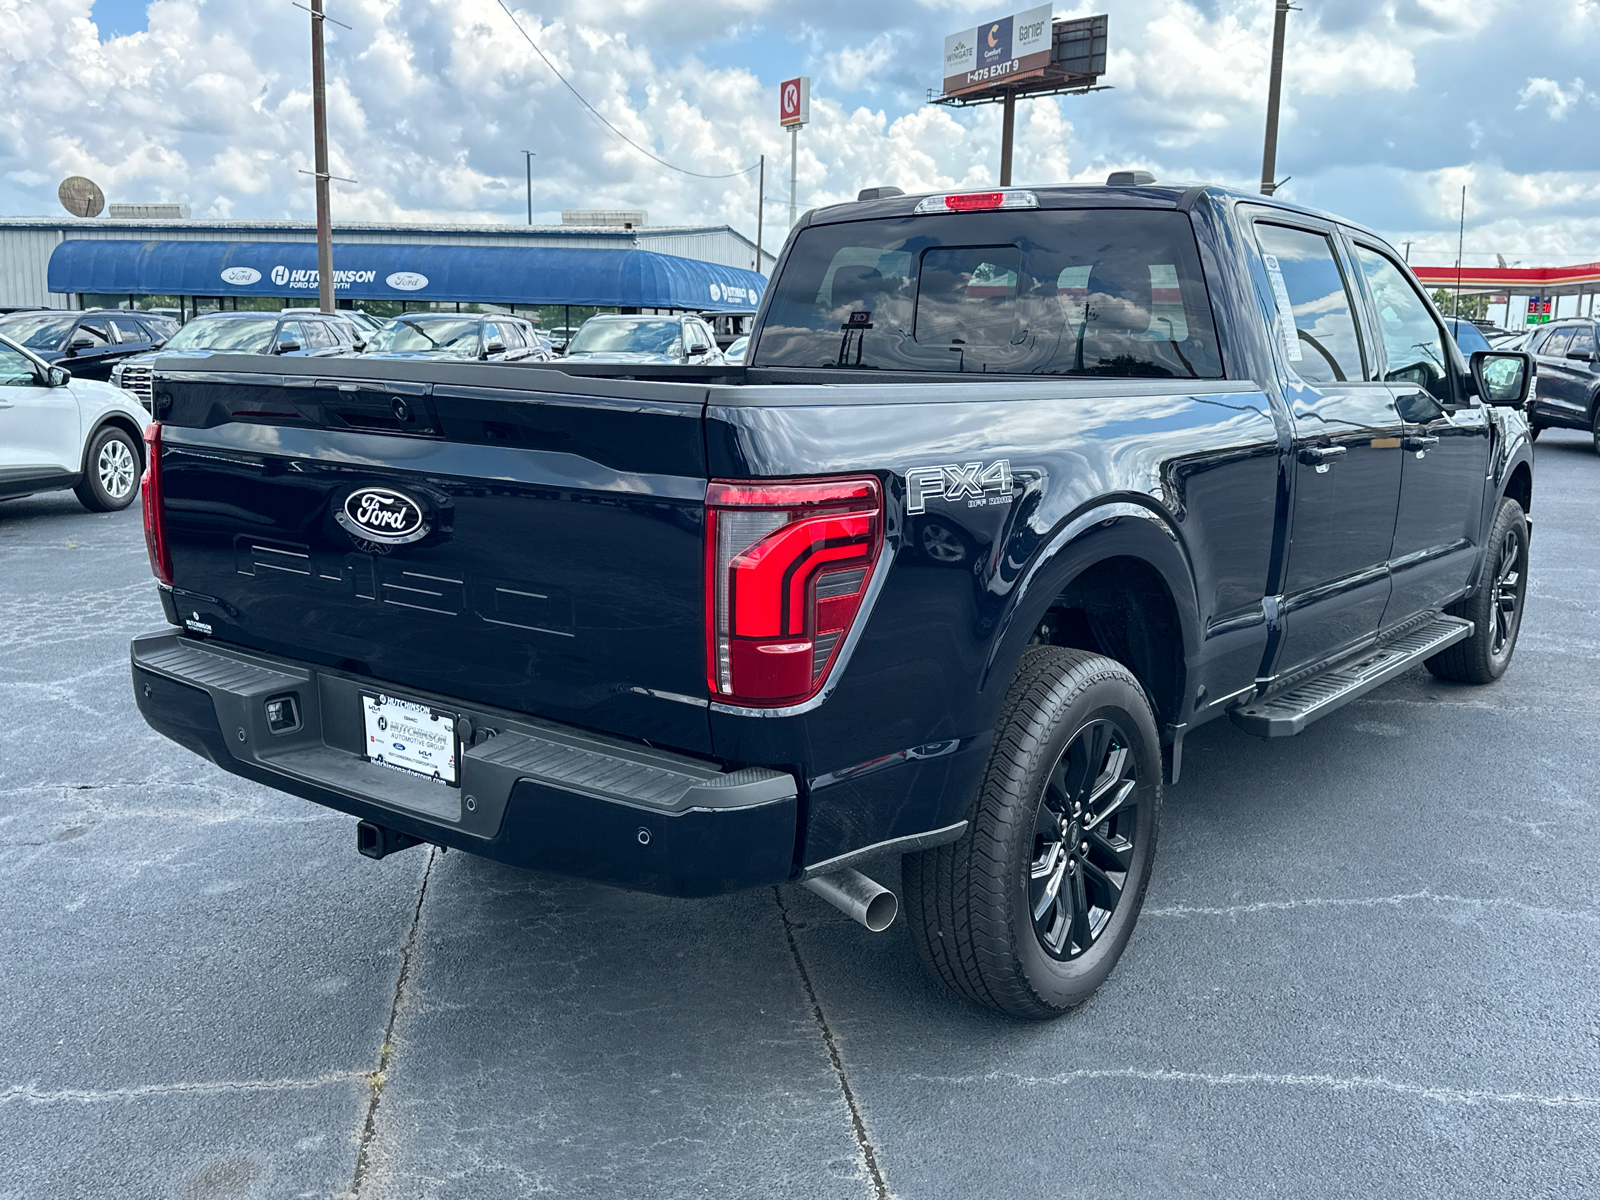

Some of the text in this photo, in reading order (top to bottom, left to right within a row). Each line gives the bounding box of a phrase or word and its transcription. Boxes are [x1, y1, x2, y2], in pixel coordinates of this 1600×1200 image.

[1019, 21, 1045, 41] Garner
[946, 47, 974, 63] WINGATE
[967, 59, 1019, 83] I-475 EXIT 9
[228, 270, 252, 281] Ford
[290, 269, 376, 283] HUTINSON
[394, 275, 419, 287] Ford
[289, 281, 309, 289] FORD
[905, 459, 1013, 516] FX4
[968, 495, 1013, 508] OFF ROAD
[357, 493, 407, 529] Ford
[387, 695, 431, 715] HUTCHINSON
[403, 715, 418, 723] GMC
[390, 721, 448, 746] HUTCHINSON
[391, 732, 425, 747] AUTOMOTIVE
[426, 741, 446, 751] GROUP
